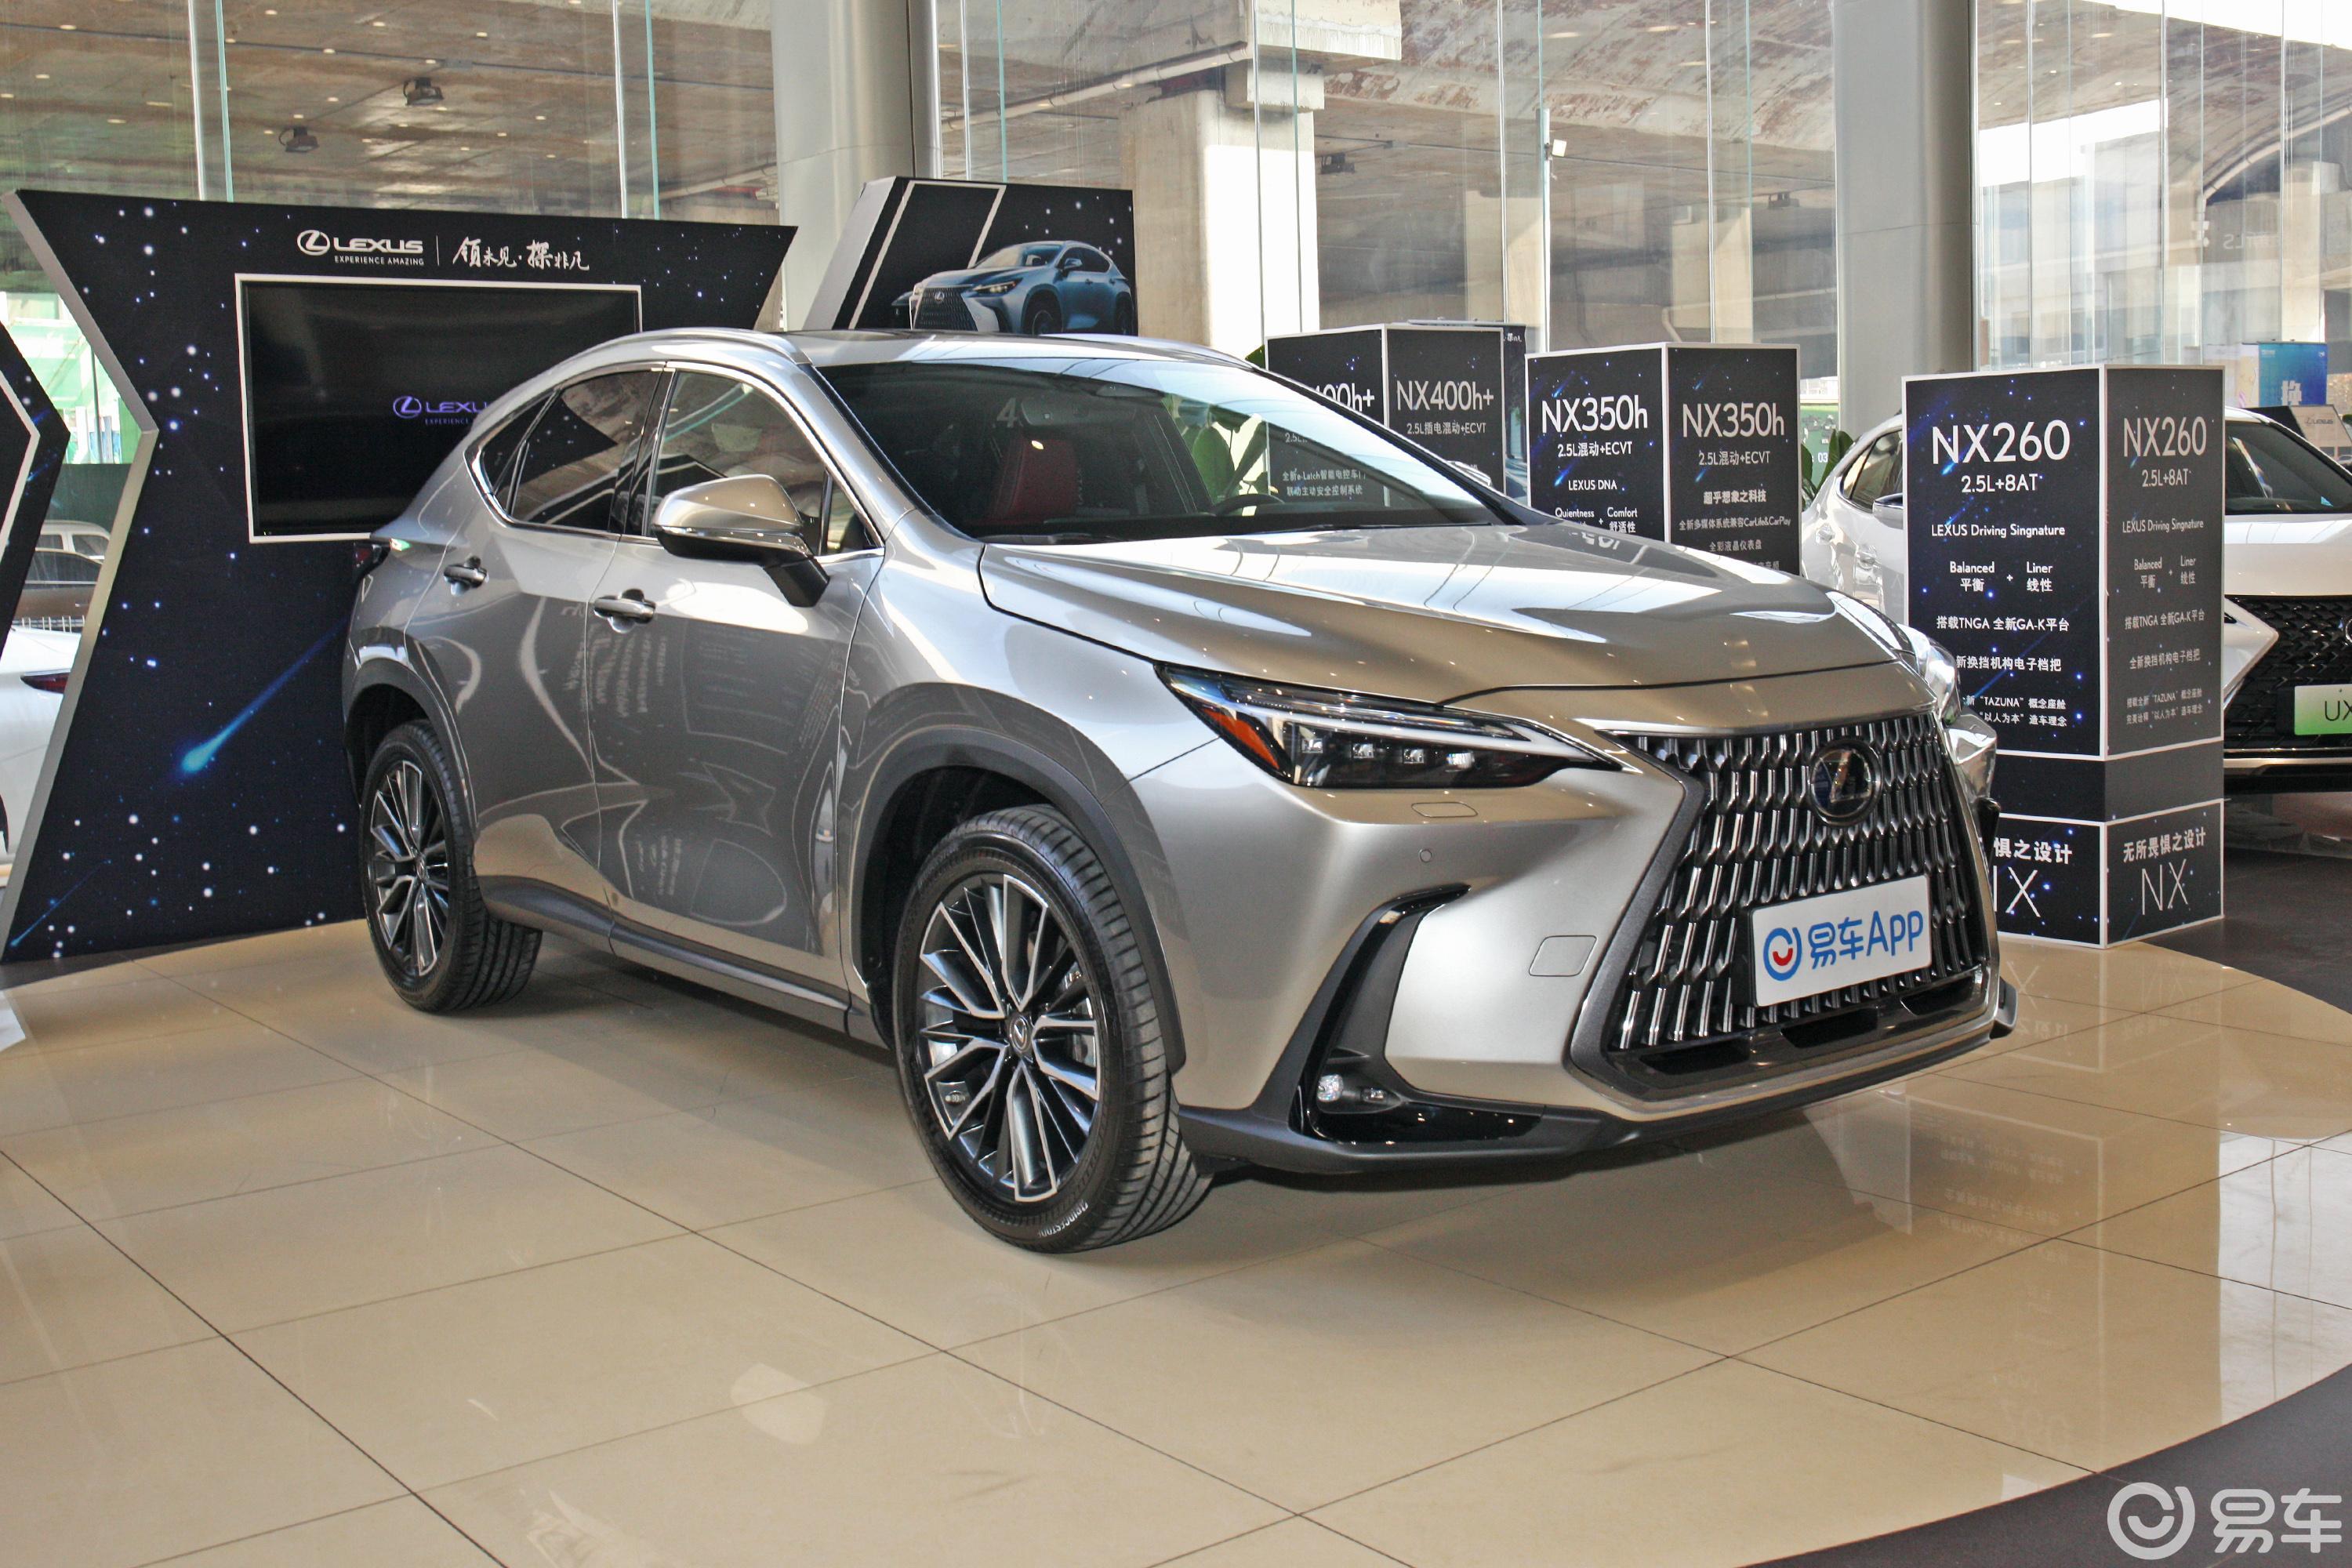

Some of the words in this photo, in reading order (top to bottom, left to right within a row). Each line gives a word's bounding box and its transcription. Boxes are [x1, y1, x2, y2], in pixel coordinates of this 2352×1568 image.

[333, 237, 423, 254] LEXUS
[334, 255, 384, 265] EXPERIENCE
[387, 257, 424, 266] AMAZING
[1396, 380, 1494, 411] NX400h+
[1541, 394, 1649, 433] NX350h
[1682, 401, 1785, 438] NX350h
[1931, 419, 2071, 465] NX260
[2123, 416, 2208, 458] NX260
[1557, 440, 1633, 458] 2.5L混动+ECVT
[1697, 450, 1771, 466] 2.5L混动+ECVT
[1568, 479, 1596, 491] LEXUS
[1597, 479, 1617, 490] DNA
[1959, 472, 2038, 495] 2.5L+8AT
[2140, 467, 2189, 489] 2.5L+8AT
[1703, 488, 1767, 505] 超乎想象之科技
[1555, 506, 1595, 519] Quientness
[1606, 506, 1638, 517] Comfort
[1609, 521, 1636, 533] 舒适性
[1930, 524, 1969, 538] LEXUS
[1970, 524, 2007, 539] Driving
[2009, 523, 2066, 539] Singnature
[2122, 520, 2146, 534] LEXUS
[2147, 519, 2170, 534] Driving
[2171, 517, 2204, 532] Singnature
[1950, 561, 1995, 574] Balanced
[2026, 561, 2053, 574] Liner
[2134, 556, 2163, 571] Balanced
[2180, 554, 2196, 567] Liner
[1959, 577, 1985, 593] 平衡
[2026, 577, 2054, 593] 线性
[2140, 575, 2157, 590] 平衡
[2180, 572, 2197, 586] 线性
[1936, 615, 1990, 630] 搭载TNGA
[1992, 617, 2071, 633] 全新GA-K平台
[2122, 826, 2207, 863] 无所畏惧之设计
[2141, 858, 2190, 916] NX
[1808, 909, 1924, 970] 易车App
